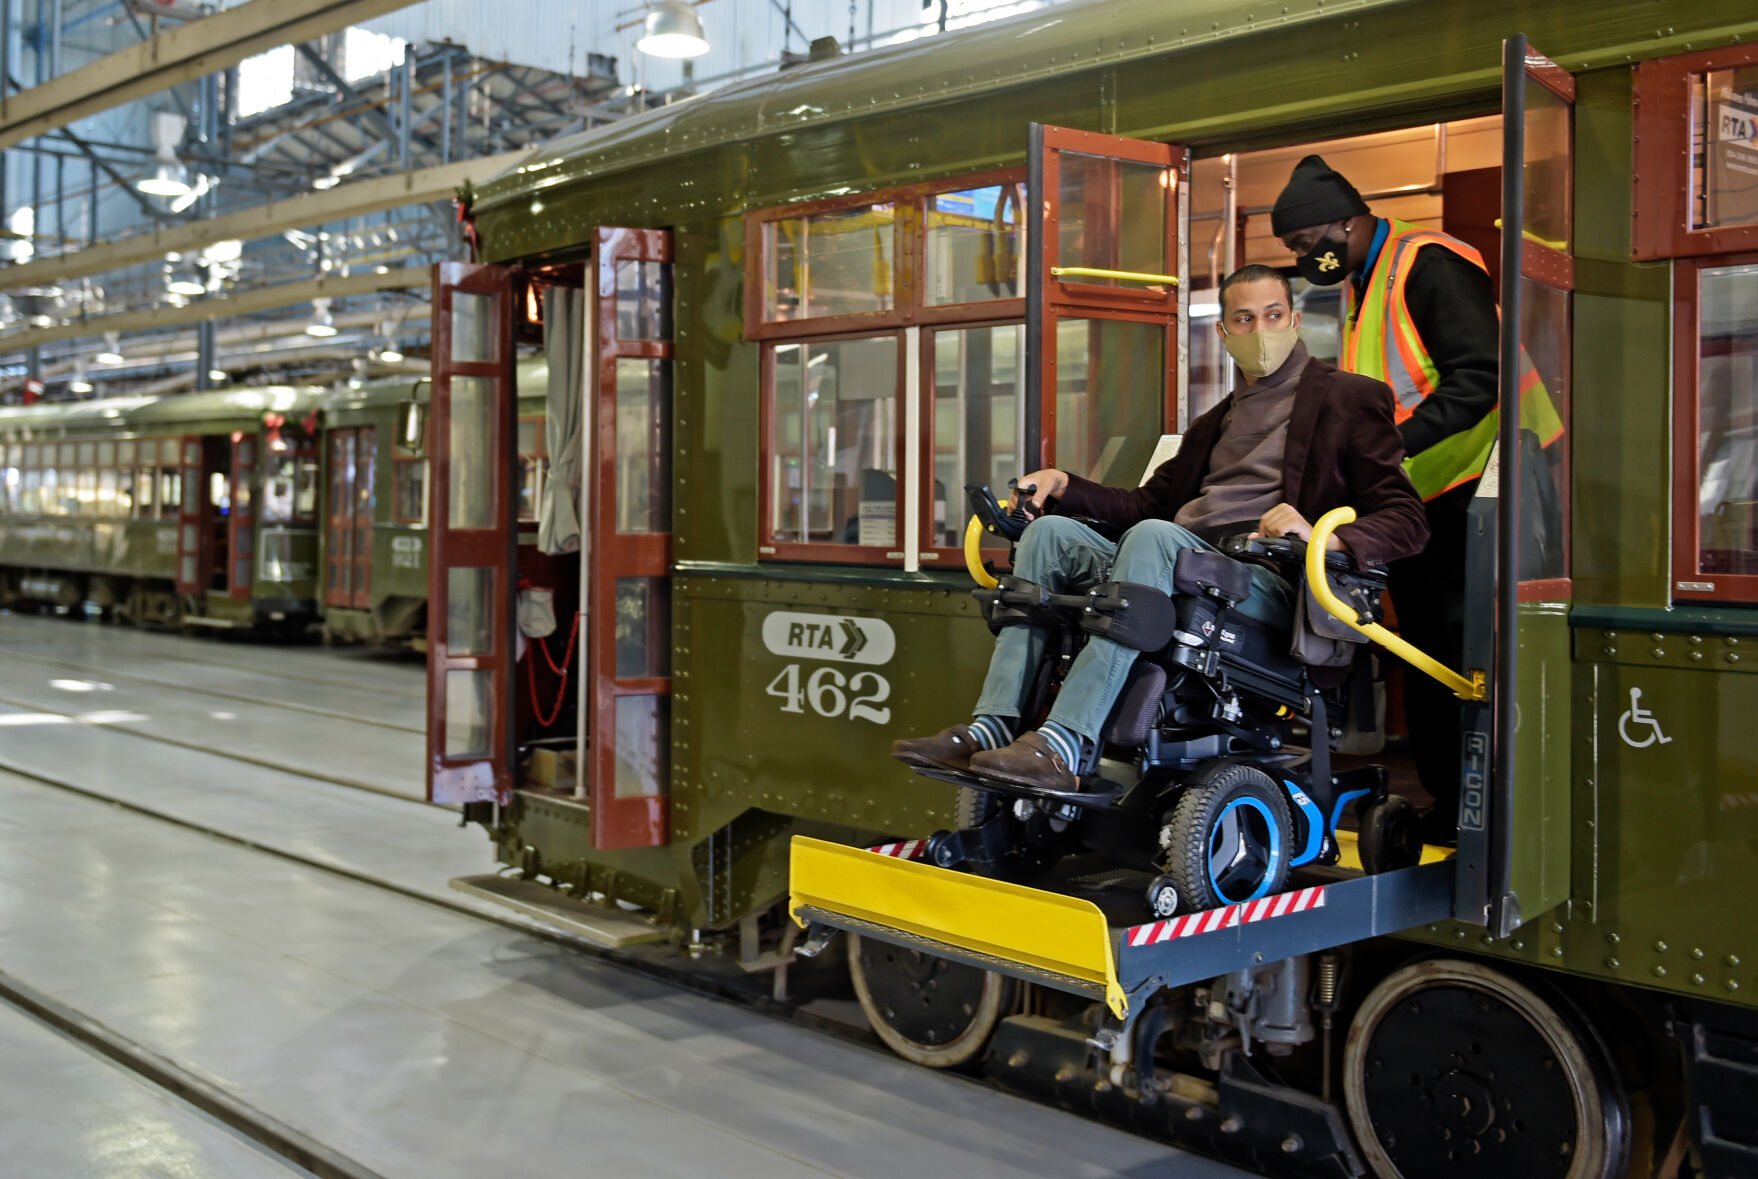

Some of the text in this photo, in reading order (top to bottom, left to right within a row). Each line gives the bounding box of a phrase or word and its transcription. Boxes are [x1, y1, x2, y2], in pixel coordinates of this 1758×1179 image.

[1721, 115, 1746, 138] RTA
[787, 622, 834, 650] RTA
[766, 664, 891, 725] 462
[1463, 737, 1484, 825] RICON
